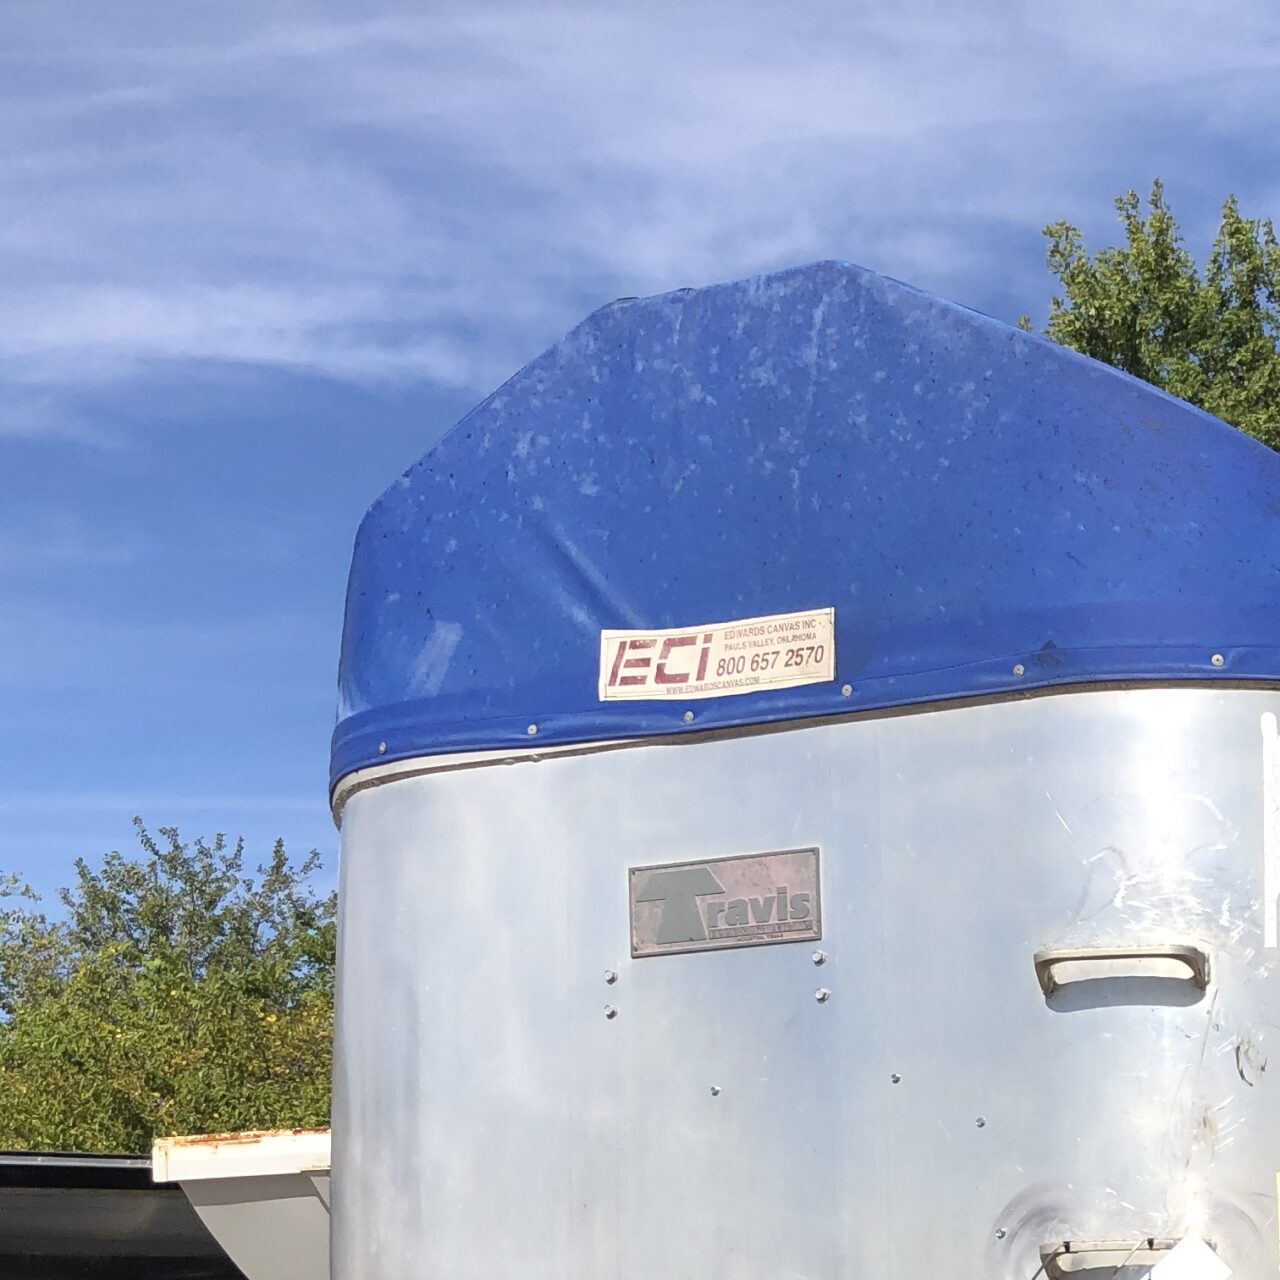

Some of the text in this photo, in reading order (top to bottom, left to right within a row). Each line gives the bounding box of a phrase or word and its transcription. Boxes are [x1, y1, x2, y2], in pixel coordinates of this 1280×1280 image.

[724, 619, 817, 640] EDWARDS CANVAS INC
[724, 641, 747, 651] PAULS
[776, 632, 817, 644] OKLAHOMA
[716, 644, 825, 677] 800 657 2570
[636, 867, 811, 944] Travis
